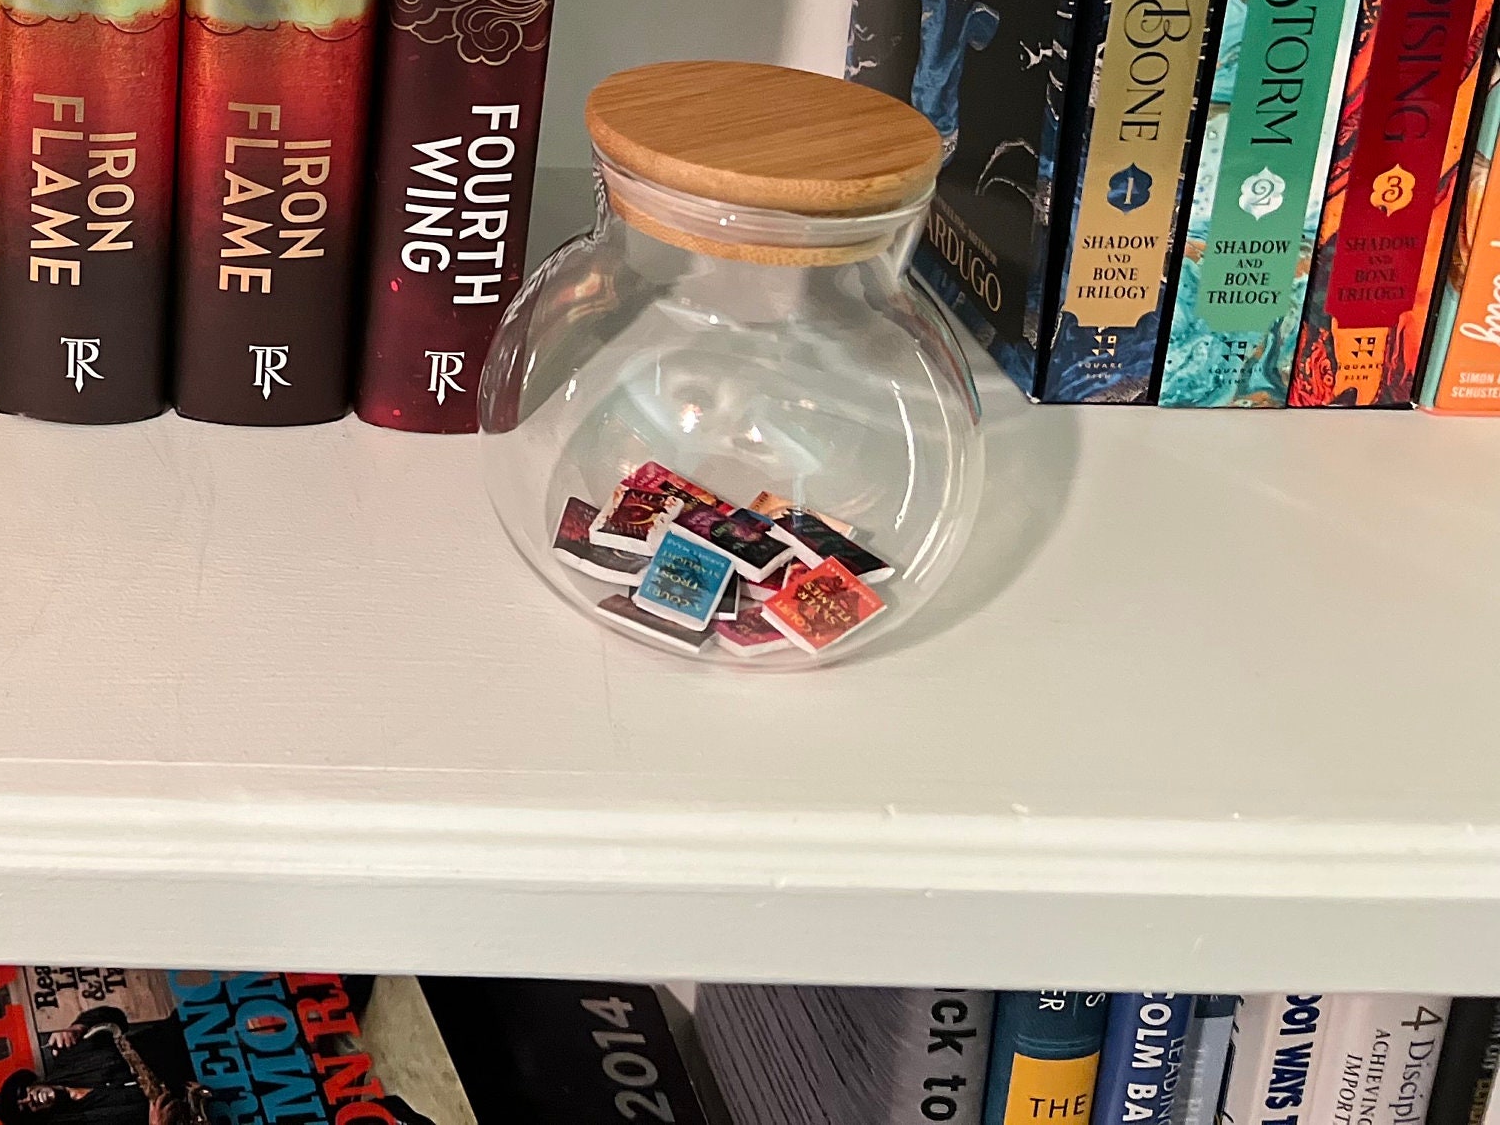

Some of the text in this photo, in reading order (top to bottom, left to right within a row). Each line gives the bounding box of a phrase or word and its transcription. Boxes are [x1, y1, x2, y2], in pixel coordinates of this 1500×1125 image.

[29, 92, 85, 287] FLAME
[86, 131, 137, 253] IRON
[218, 101, 282, 294] FLAME
[278, 139, 332, 261] IRON
[1250, 178, 1275, 206] 2
[1381, 176, 1404, 203] 3
[401, 136, 463, 274] WING
[452, 104, 520, 306] FOURTH
[1082, 235, 1159, 249] SHADOW
[1214, 240, 1291, 254] SHADOW
[927, 212, 1001, 312] ARDUGO
[1107, 254, 1132, 264] AND
[1236, 259, 1263, 269] AND
[1093, 267, 1139, 281] BONE
[1224, 273, 1270, 286] BONE
[1076, 286, 1150, 299] TRILOGY
[1207, 291, 1282, 304] TRILOGY
[1459, 373, 1495, 384] SIMON
[1132, 991, 1175, 1069] OLM
[1401, 1006, 1444, 1031] 4
[580, 995, 676, 1125] 2014
[921, 988, 977, 1121] ck to
[1265, 1041, 1314, 1110] WAYS
[1029, 1093, 1088, 1119] THE
